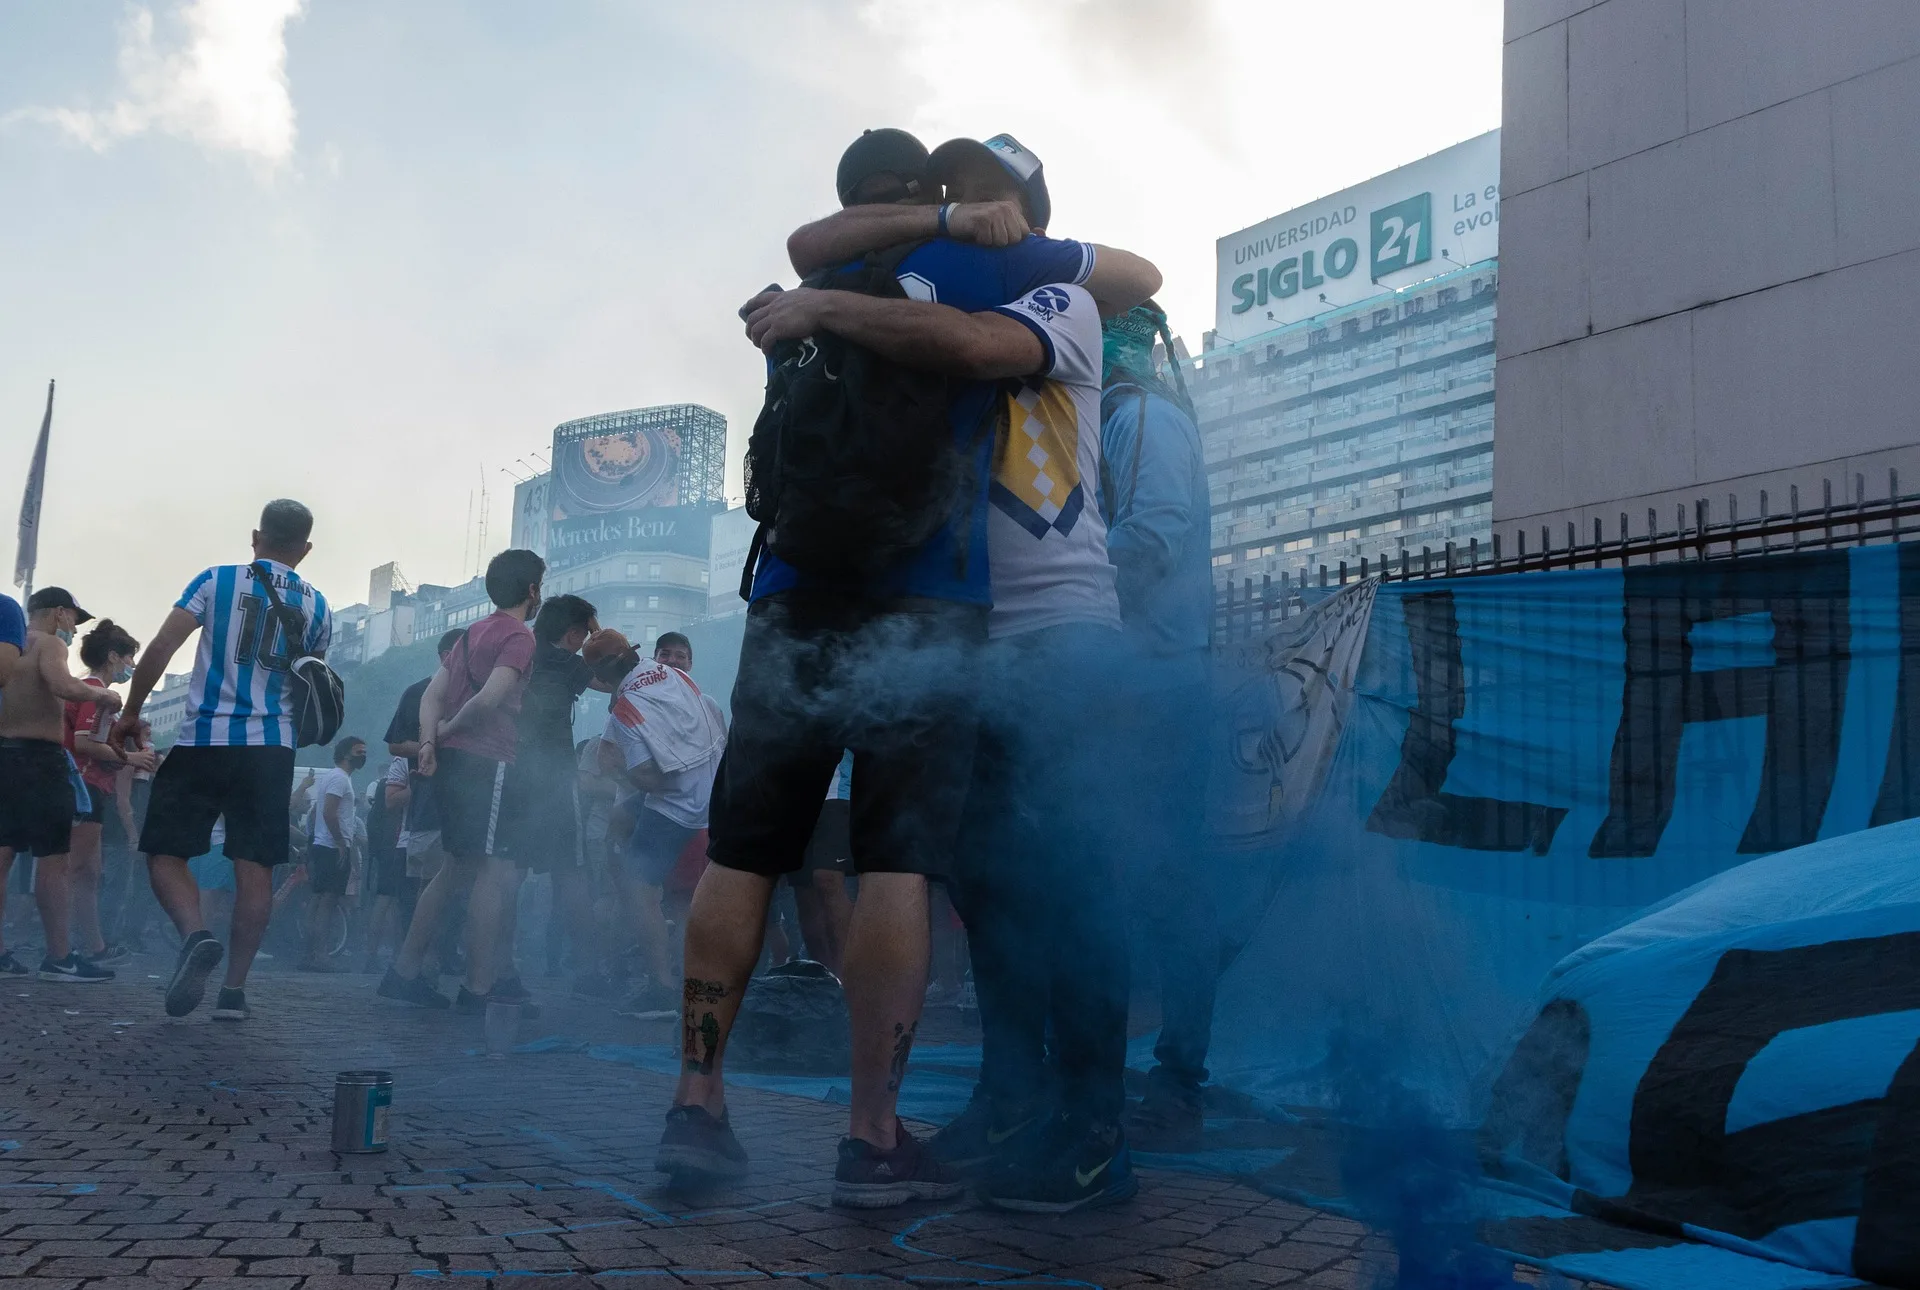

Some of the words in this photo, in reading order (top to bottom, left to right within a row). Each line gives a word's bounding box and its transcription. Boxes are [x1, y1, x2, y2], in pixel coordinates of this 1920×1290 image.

[1453, 193, 1476, 213] La
[1484, 184, 1501, 201] e
[1235, 206, 1357, 266] UNIVERSIDAD
[1231, 237, 1359, 315] SIGLO
[1376, 215, 1422, 264] 21
[1111, 319, 1152, 337] MATADOR
[549, 515, 677, 550] Mercedes-Benz
[245, 567, 312, 598] MRADONA
[234, 592, 308, 673] 10
